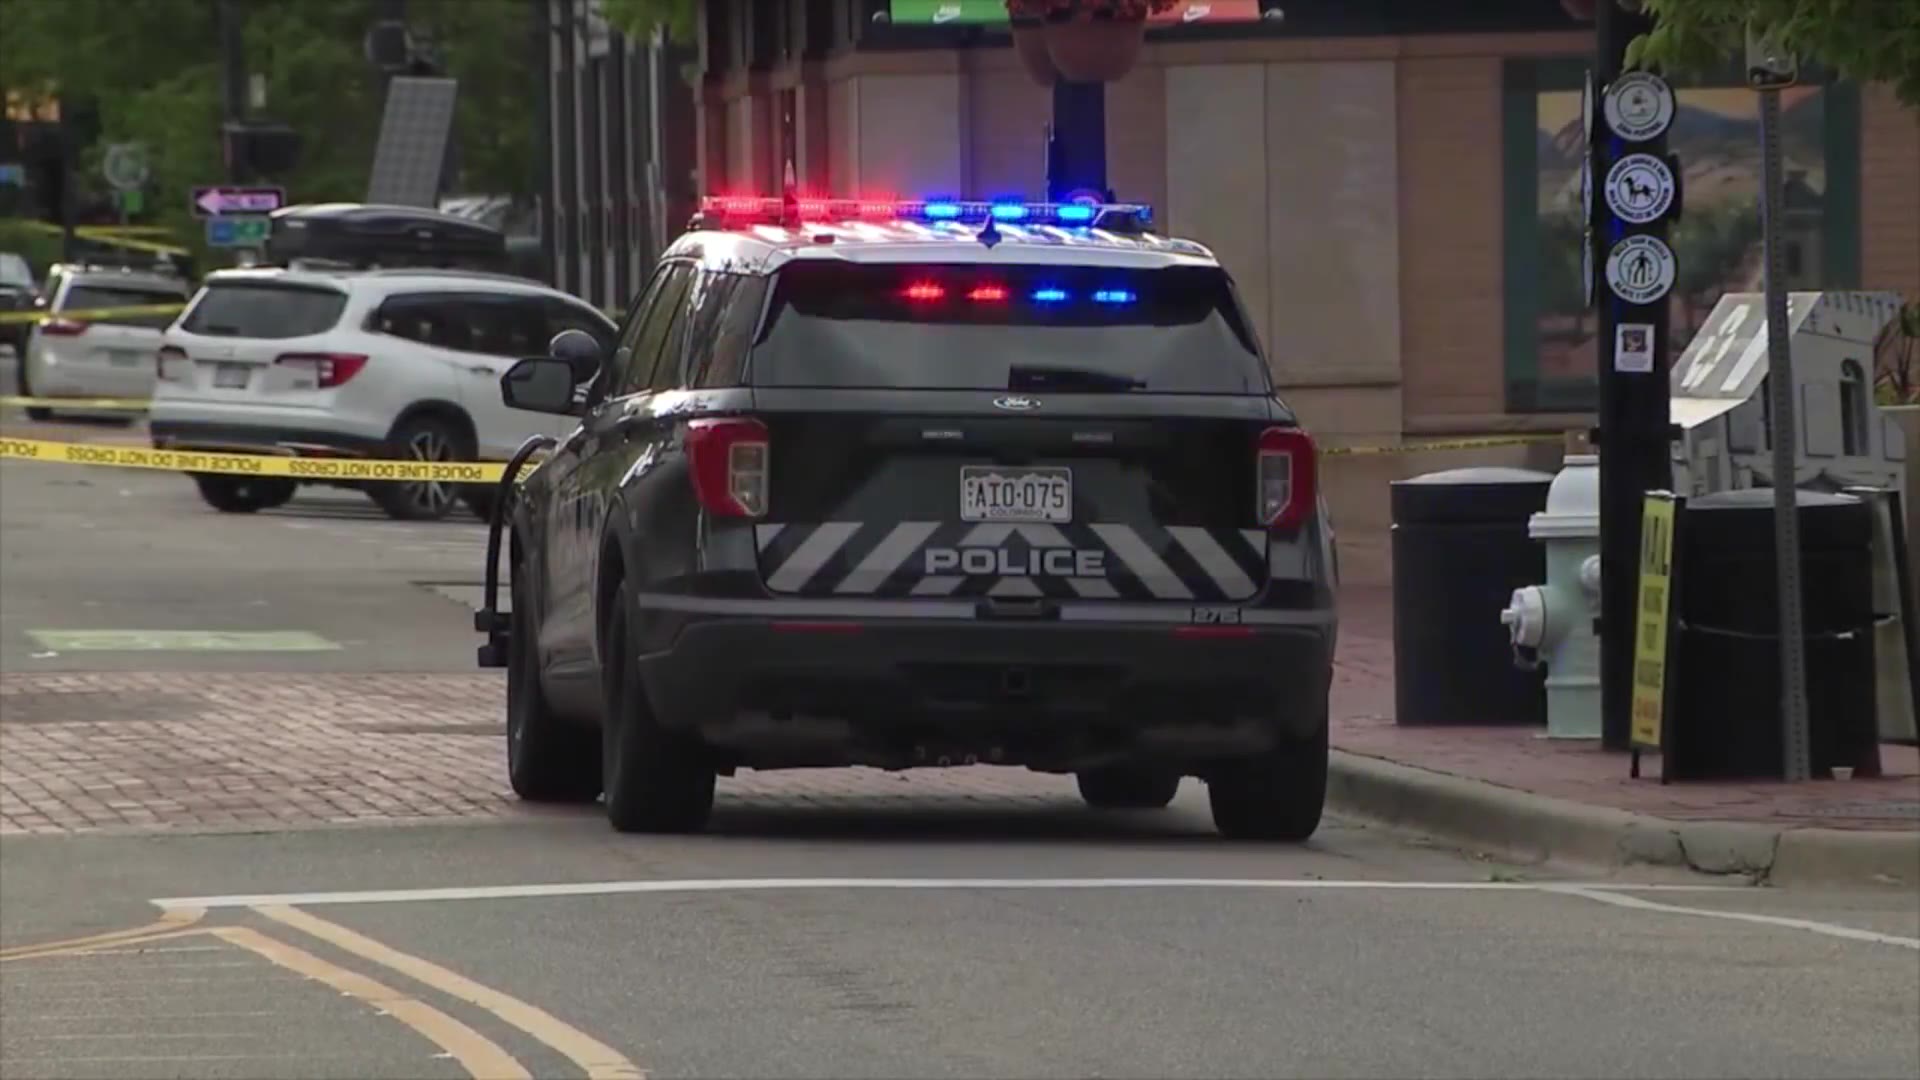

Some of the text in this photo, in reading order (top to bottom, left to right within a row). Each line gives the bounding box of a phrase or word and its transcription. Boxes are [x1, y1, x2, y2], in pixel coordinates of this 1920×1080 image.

[65, 446, 261, 473] POLICE LINE DO NOT CROSS
[288, 459, 483, 480] POLICE LINE DO NOT CROSS
[925, 548, 1106, 575] POLICE
